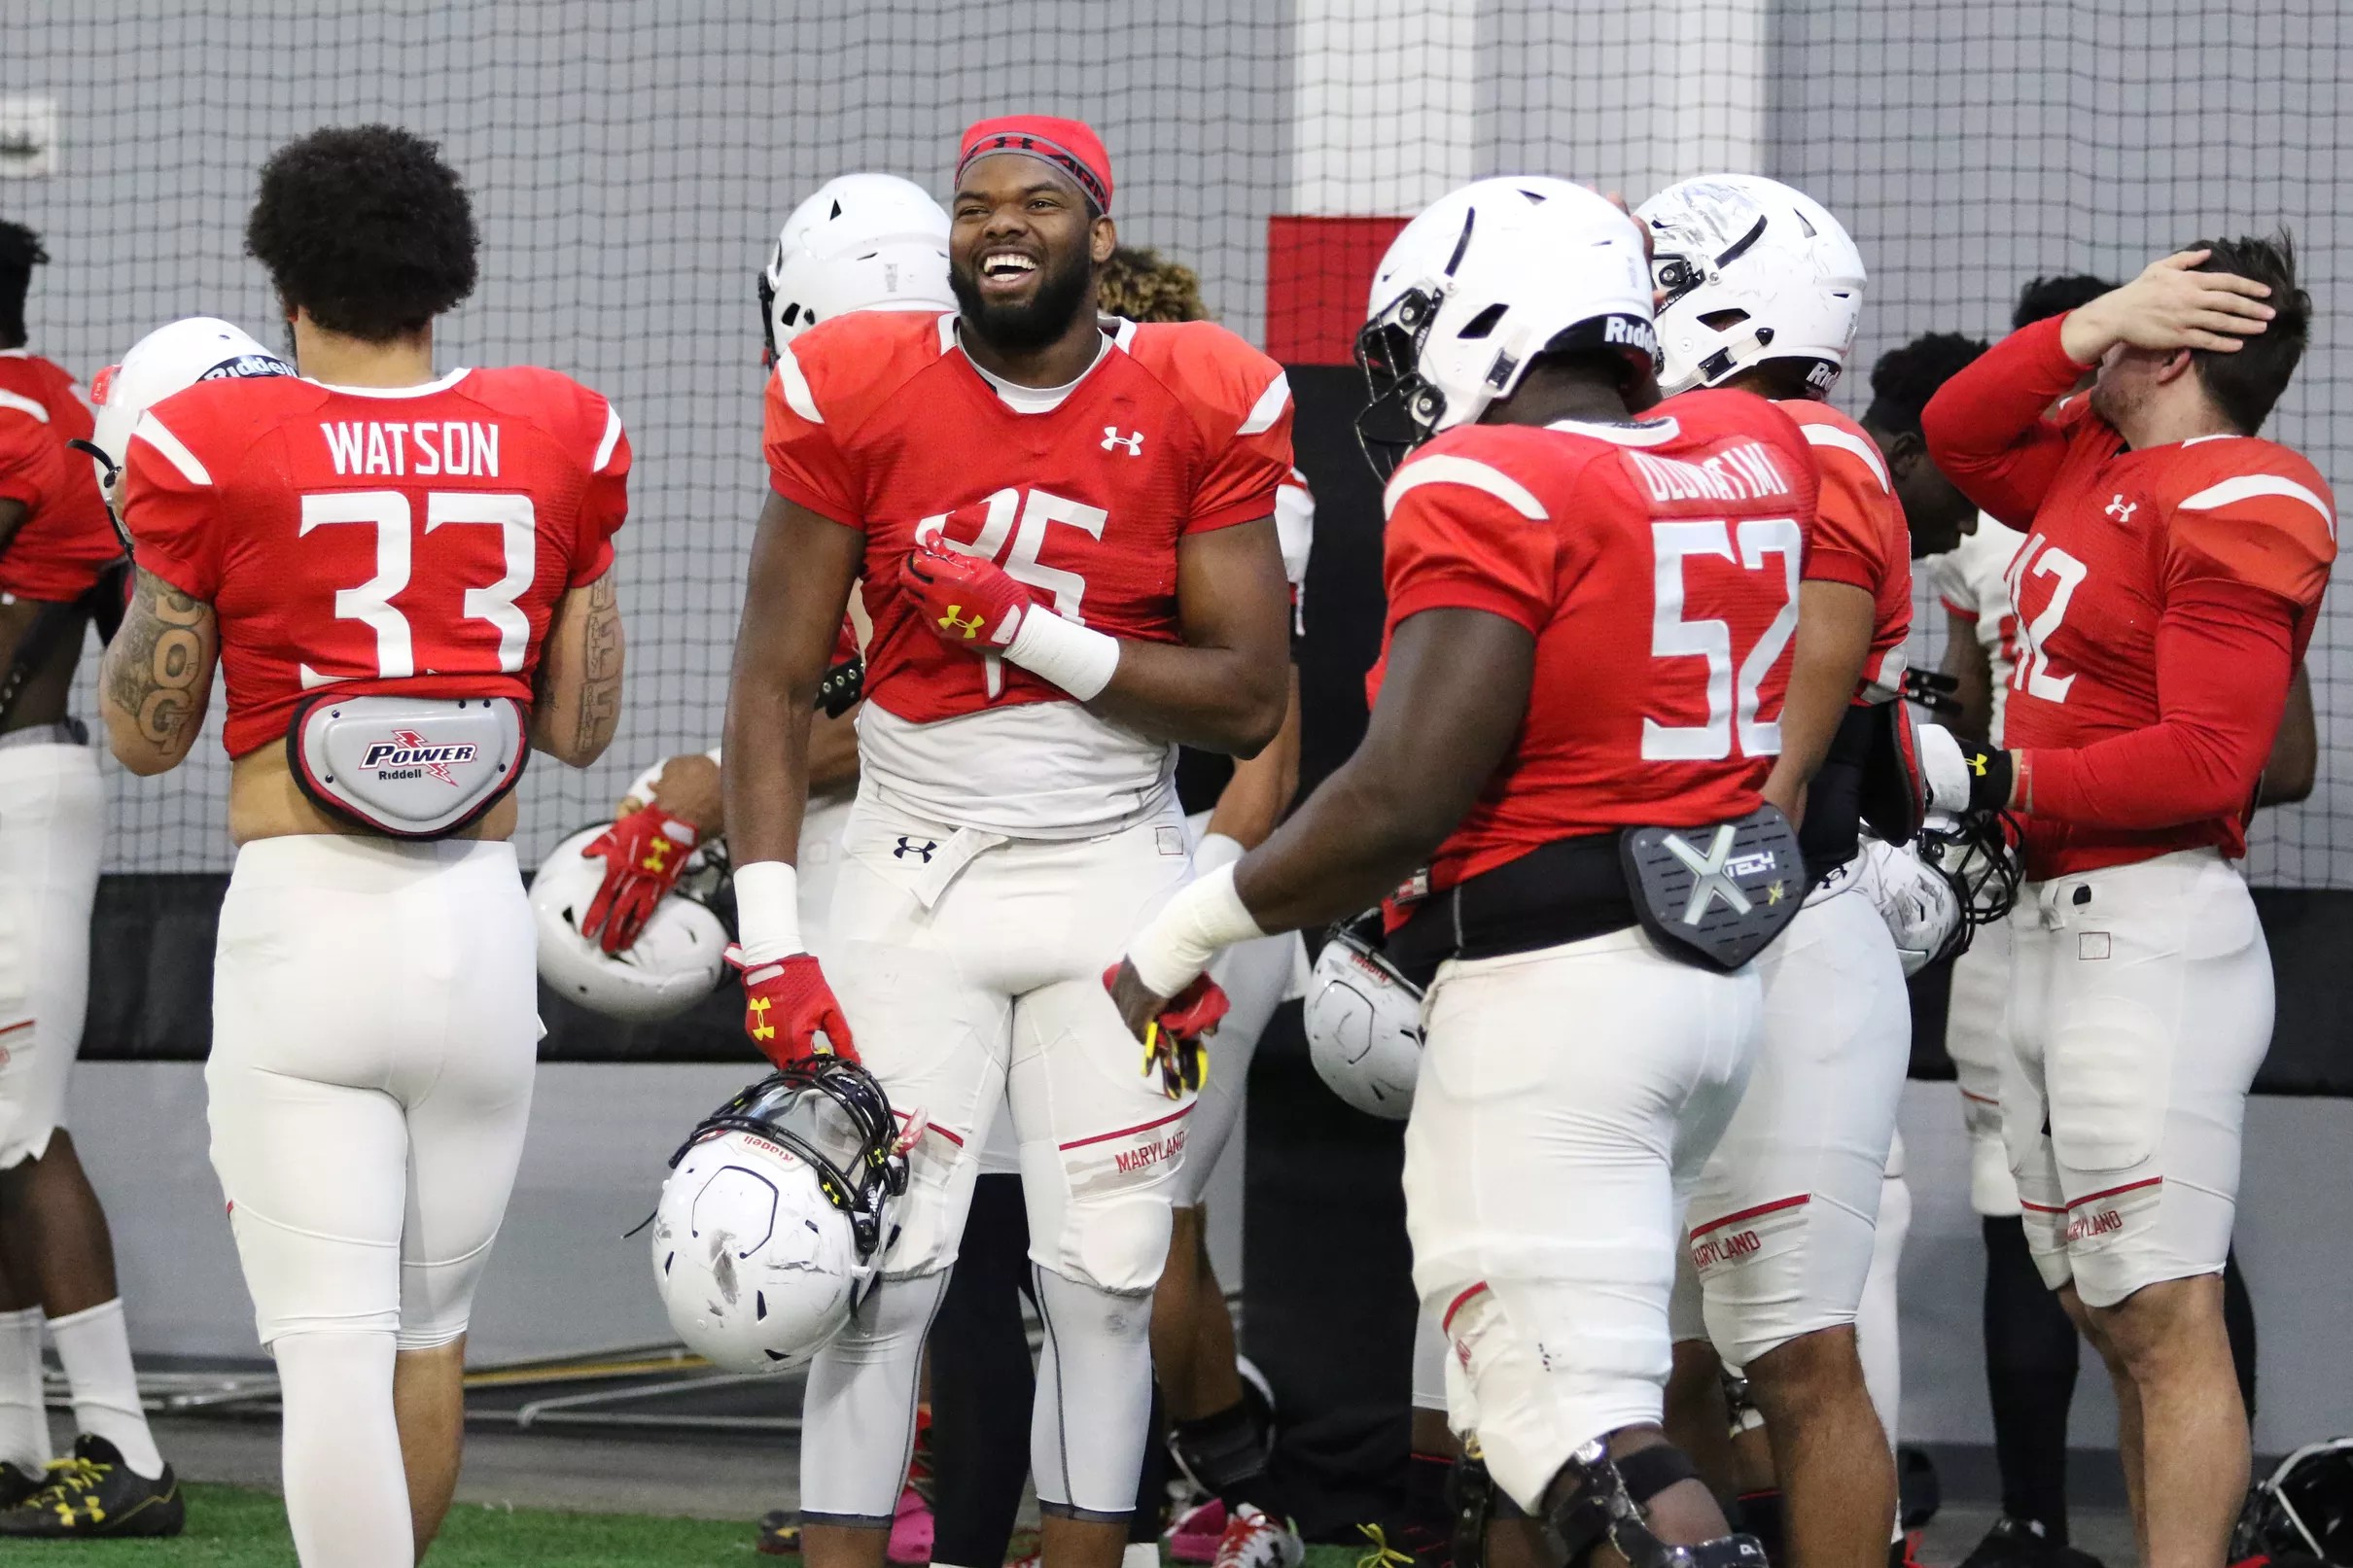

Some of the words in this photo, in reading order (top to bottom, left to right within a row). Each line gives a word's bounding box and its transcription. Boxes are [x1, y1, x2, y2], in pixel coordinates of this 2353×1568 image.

[320, 422, 499, 477] WATSON
[1629, 441, 1789, 503] OLUWATIMI
[299, 490, 536, 690] 33
[1641, 518, 1802, 760] 52
[360, 743, 476, 768] POWER
[378, 769, 422, 781] Riddell
[1115, 1131, 1185, 1174] MARYLAND
